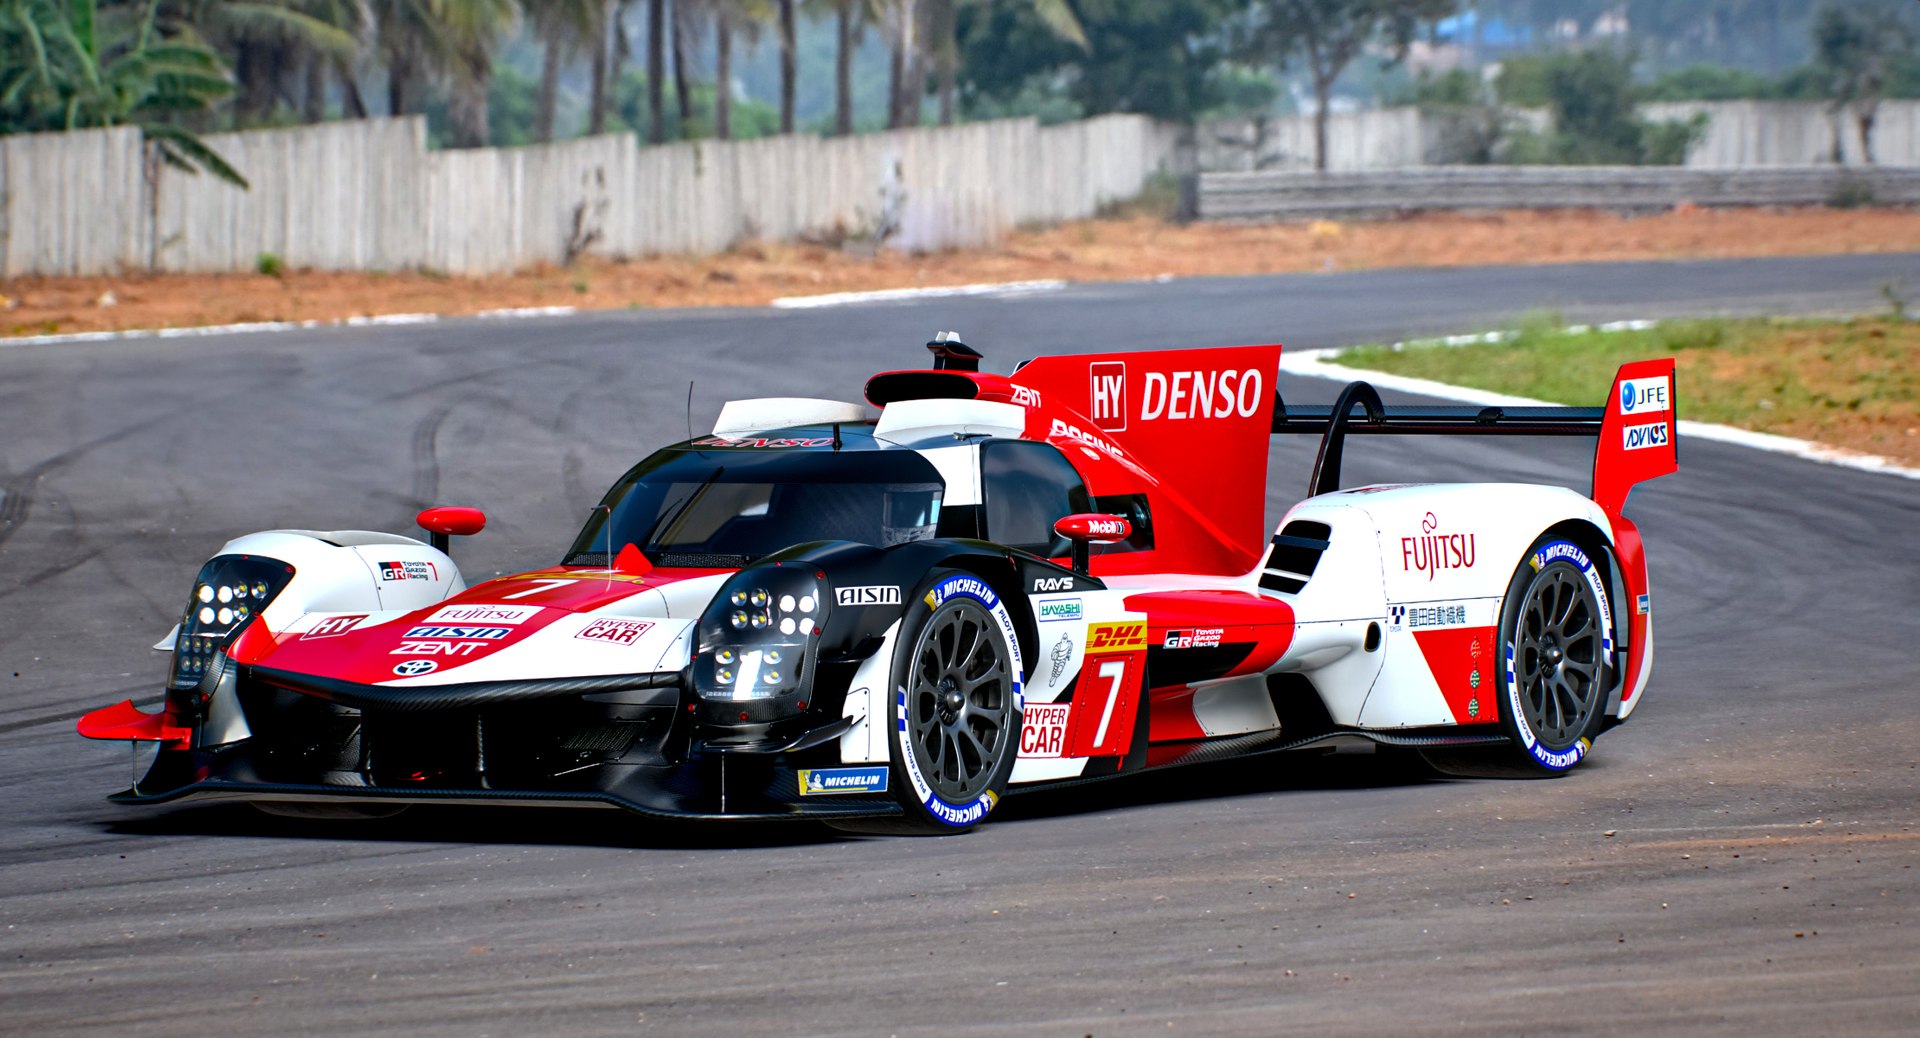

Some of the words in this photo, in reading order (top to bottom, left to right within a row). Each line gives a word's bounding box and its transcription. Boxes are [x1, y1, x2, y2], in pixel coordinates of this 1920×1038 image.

[1010, 384, 1041, 408] ZENT
[1093, 375, 1123, 418] HY
[1141, 369, 1262, 420] DENSO
[1637, 386, 1666, 405] JFE
[1625, 424, 1667, 448] ADVICS
[1088, 520, 1117, 534] Mobil
[1401, 533, 1475, 581] FUJITSU
[1545, 544, 1589, 568] MICHELIN
[407, 573, 429, 581] Racing
[1034, 577, 1074, 592] RAYS
[501, 578, 581, 599] 7
[840, 587, 899, 603] AISIN
[944, 579, 995, 605] MICHELIN
[1591, 572, 1604, 593] PILOT
[1600, 594, 1610, 620] SPORT
[440, 609, 524, 621] FUJITSU
[1041, 603, 1081, 616] HAYASHI
[308, 618, 363, 635] HY
[405, 627, 510, 638] AISIN
[583, 626, 638, 643] CAR
[595, 620, 648, 631] HYPER
[998, 609, 1013, 632] PILOT
[1009, 633, 1021, 663] SPORT
[1092, 625, 1144, 648] DHL
[388, 641, 489, 656] ZENT
[1164, 636, 1192, 649] GR
[1092, 661, 1125, 748] 7
[1023, 708, 1065, 725] HYPER
[1020, 726, 1062, 753] CAR
[905, 740, 916, 769] SPORT
[1534, 744, 1579, 768] MICHELIN
[824, 775, 880, 787] MICHELIN
[914, 770, 927, 794] PILOT
[930, 798, 982, 823] MICHELIN
